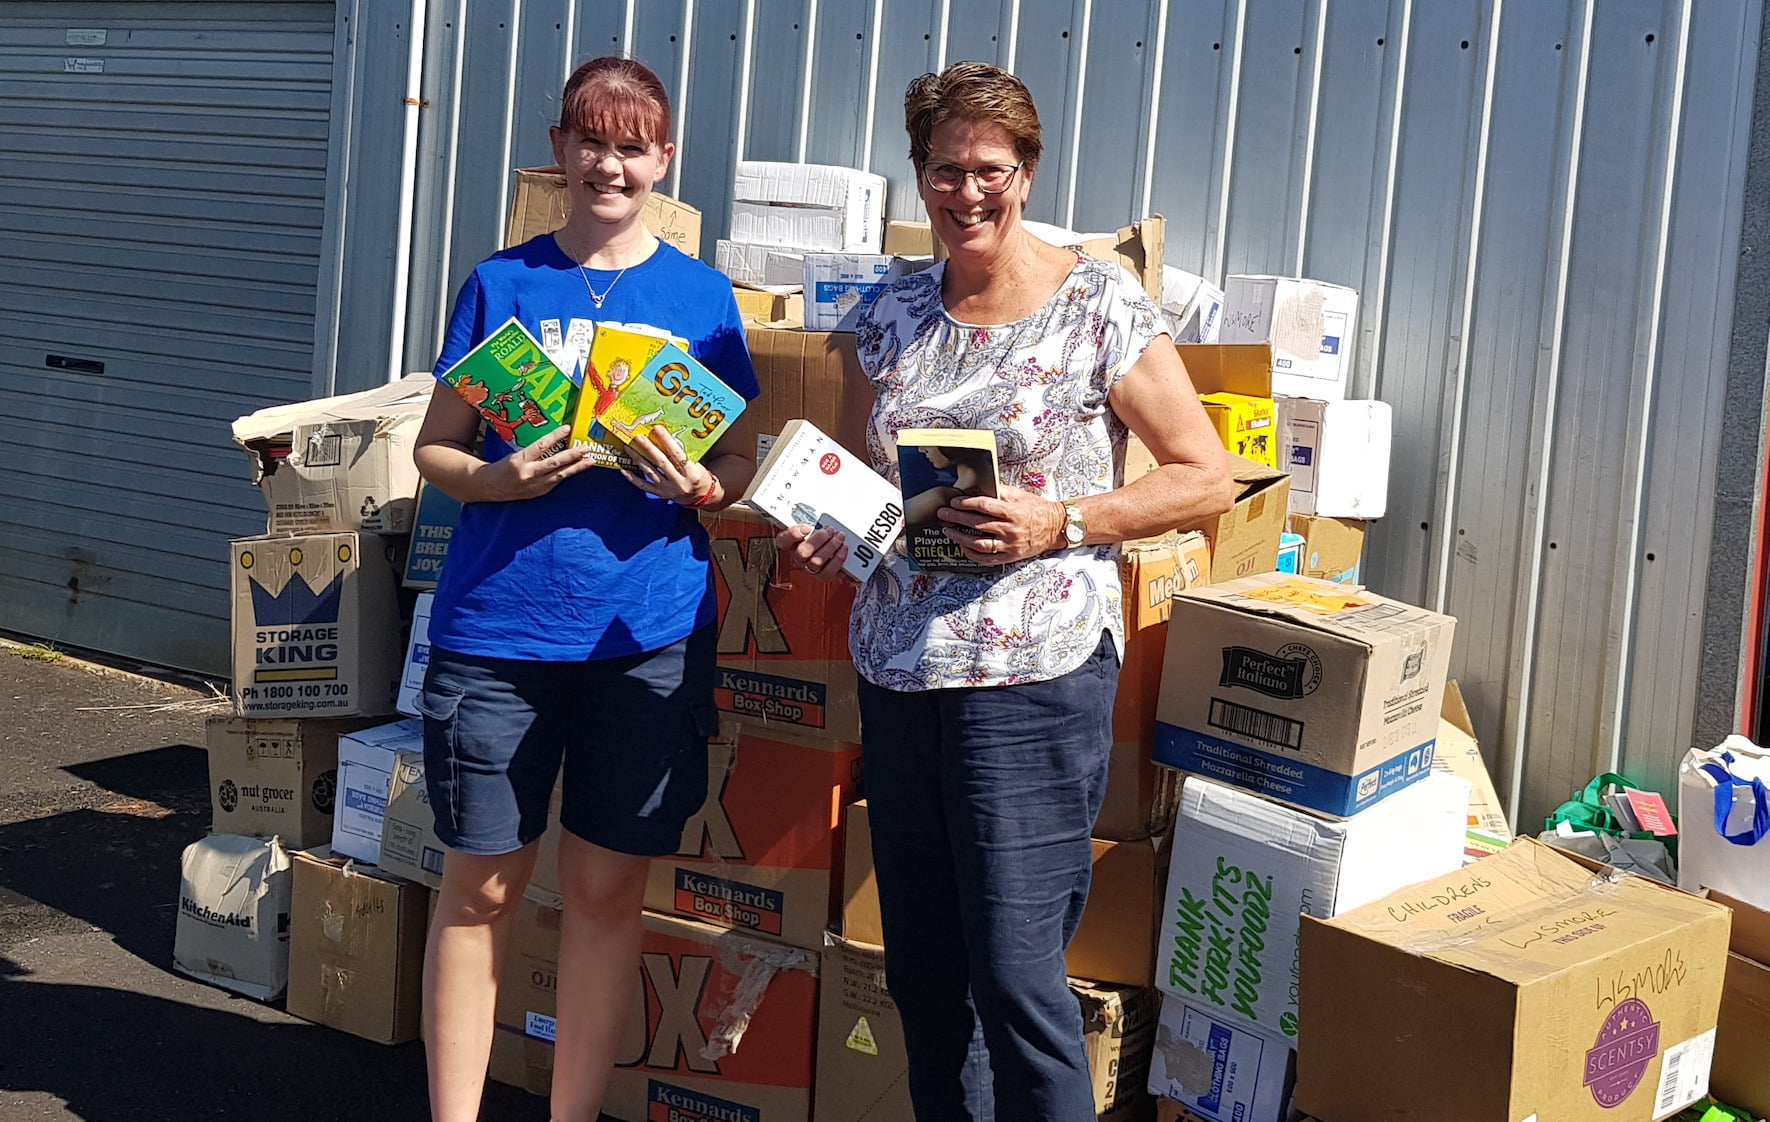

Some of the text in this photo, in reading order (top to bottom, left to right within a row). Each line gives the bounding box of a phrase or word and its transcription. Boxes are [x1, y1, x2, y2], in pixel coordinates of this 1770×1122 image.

[823, 284, 844, 292] BAGS
[494, 333, 526, 361] ROALD
[1319, 344, 1333, 353] AGS
[1276, 359, 1292, 369] 400
[500, 340, 574, 426] DAH
[654, 362, 726, 439] Grug
[419, 525, 453, 539] THIS
[914, 537, 950, 546] Played
[922, 528, 940, 536] The
[411, 559, 443, 572] JOY
[852, 544, 875, 569] JO
[914, 546, 944, 558] STIEG
[1150, 558, 1200, 609] Medm
[256, 628, 338, 643] STORAGE
[256, 644, 338, 665] KING
[1242, 656, 1287, 678] Perfect
[1288, 645, 1321, 685] CHEFS CHOICE
[243, 684, 348, 699] Ph 1800 100 700
[720, 671, 818, 704] Kennards
[1238, 667, 1288, 691] Italiano
[244, 700, 349, 712] www.storageking.com.au
[734, 694, 803, 721] Box Shop
[1196, 740, 1253, 765] Traditional
[1254, 757, 1304, 779] Shredded
[1201, 760, 1293, 795] Mozzarella Cheese
[241, 784, 294, 804] nut grocer
[251, 804, 285, 814] AUSTRALIA
[682, 873, 776, 911] Kennards
[1387, 877, 1491, 923] CHILDRENS
[182, 896, 251, 928] KitchenAid
[694, 896, 760, 927] Box Shop
[1447, 904, 1486, 924] FRAGILE
[1169, 887, 1207, 994] THANK
[1201, 856, 1242, 1006] FORK! IT'S
[1499, 908, 1617, 949] LISMORE
[1552, 934, 1571, 945] THIS
[1570, 928, 1591, 942] SIDE
[1230, 871, 1274, 1021] YOUFOODZ.
[1596, 948, 1687, 1010] LISMORE
[1601, 1004, 1648, 1040] AUTHENTIC
[1588, 1032, 1655, 1075] SCENTSY
[1209, 1036, 1230, 1104] CLOTHING BAGS
[1598, 1072, 1640, 1103] PRODUCT
[656, 1086, 752, 1122] Kennards
